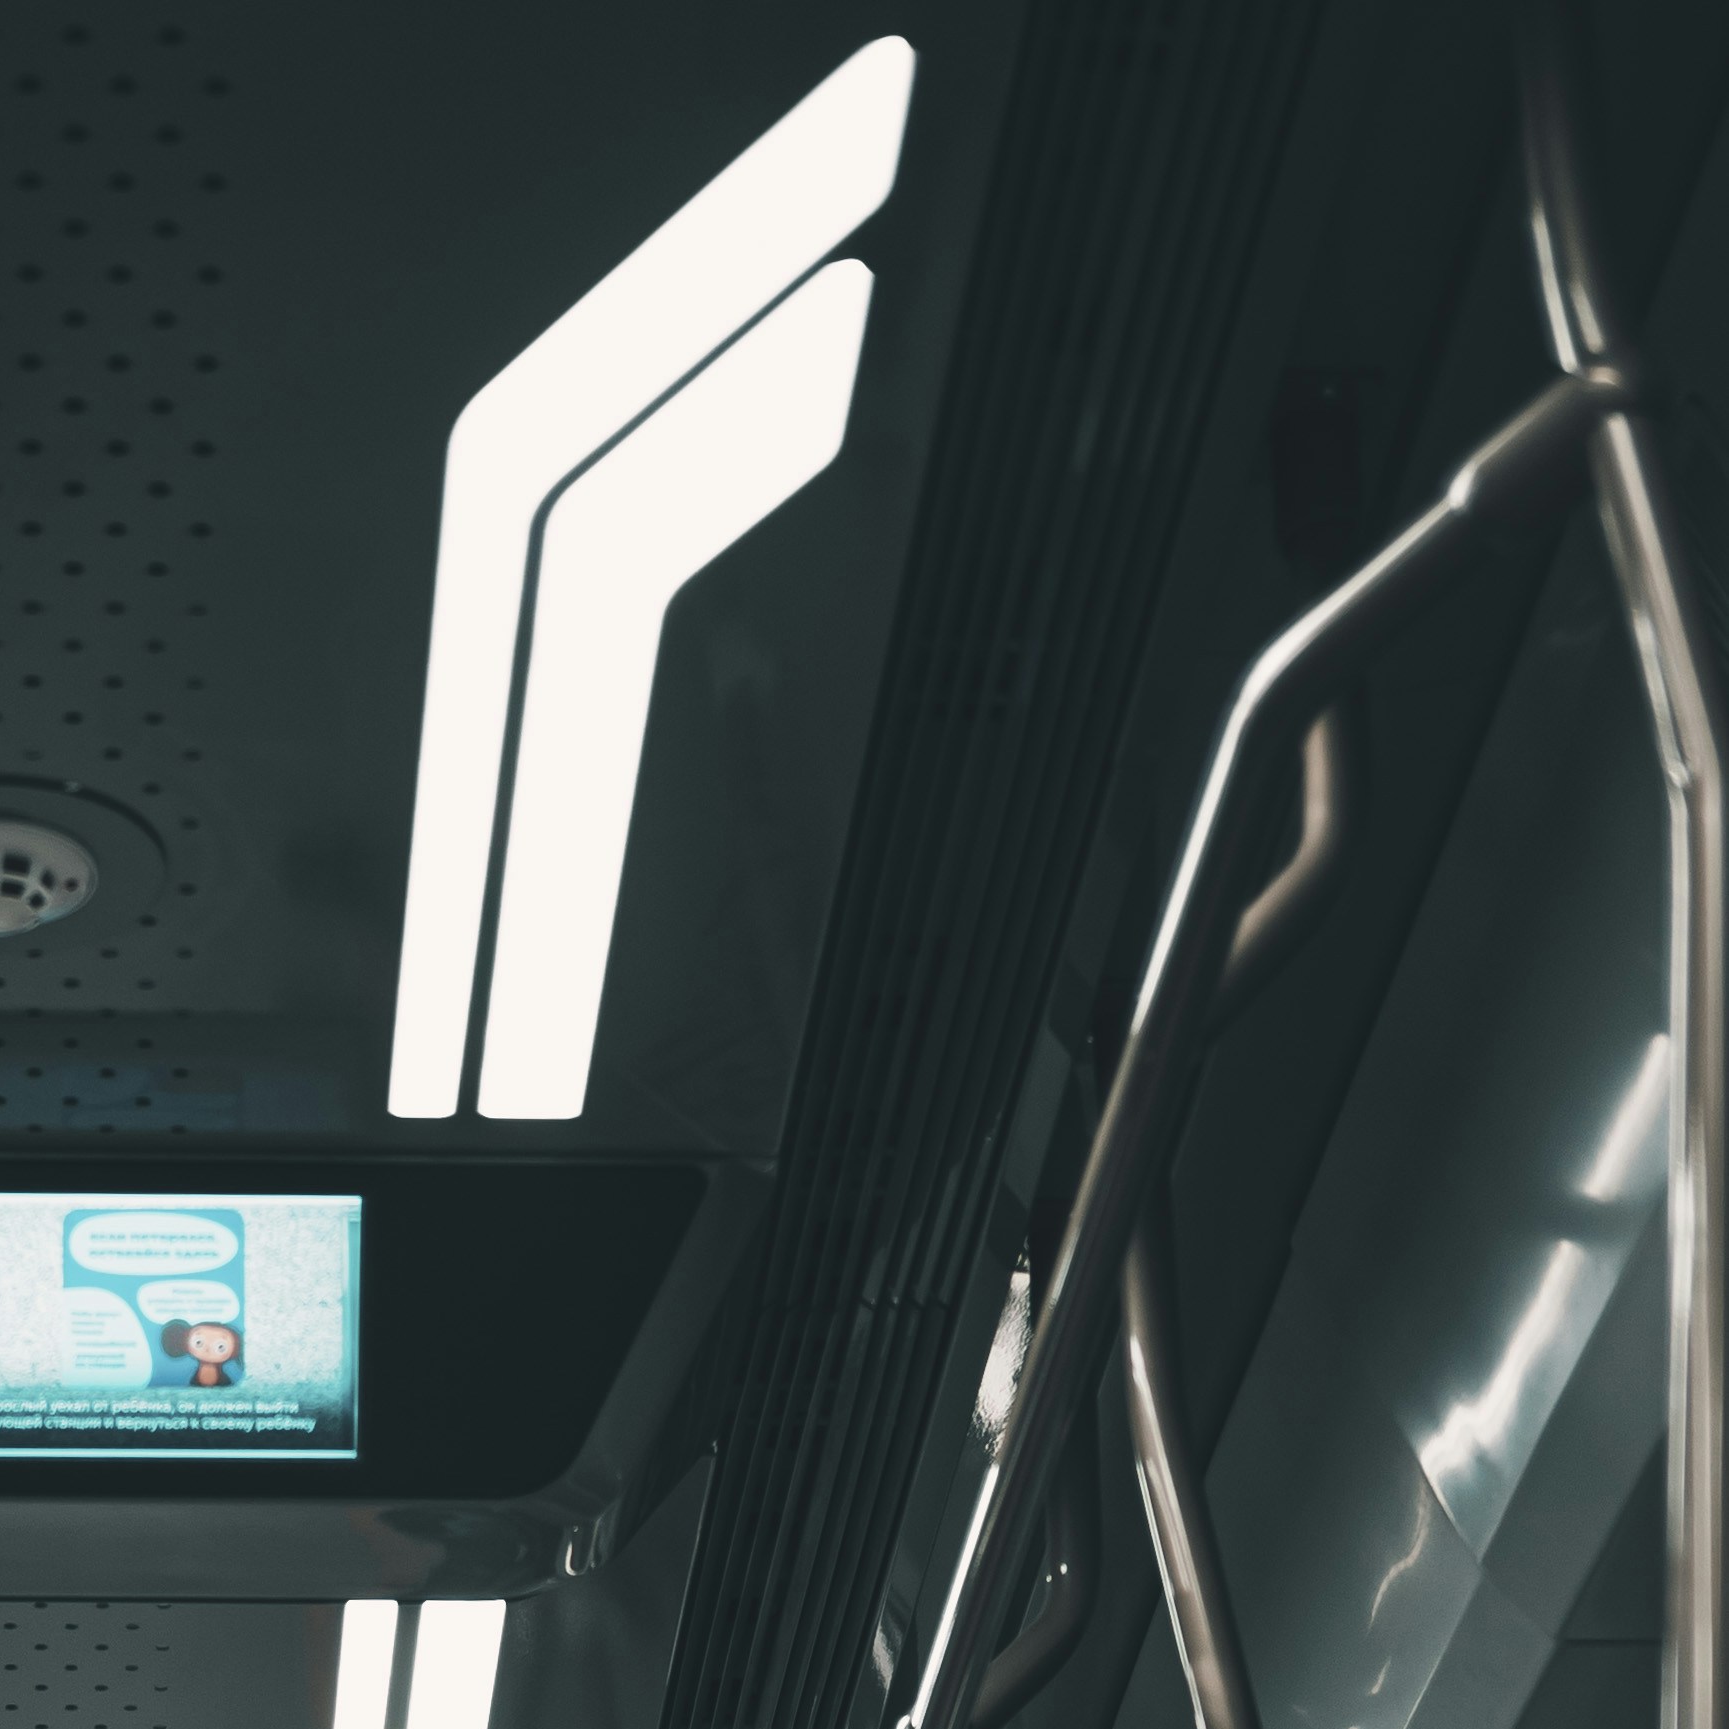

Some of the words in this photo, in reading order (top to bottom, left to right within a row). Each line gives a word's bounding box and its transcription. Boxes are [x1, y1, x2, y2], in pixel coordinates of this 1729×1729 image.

[49, 1400, 90, 1415] уехал
[93, 1401, 108, 1412] от
[177, 1402, 196, 1413] он
[198, 1401, 253, 1414] должен
[256, 1400, 299, 1414] выйти
[45, 1416, 102, 1430] станции
[104, 1417, 114, 1429] и
[116, 1417, 188, 1431] вернуться
[190, 1418, 199, 1429] к
[201, 1418, 254, 1432] своему
